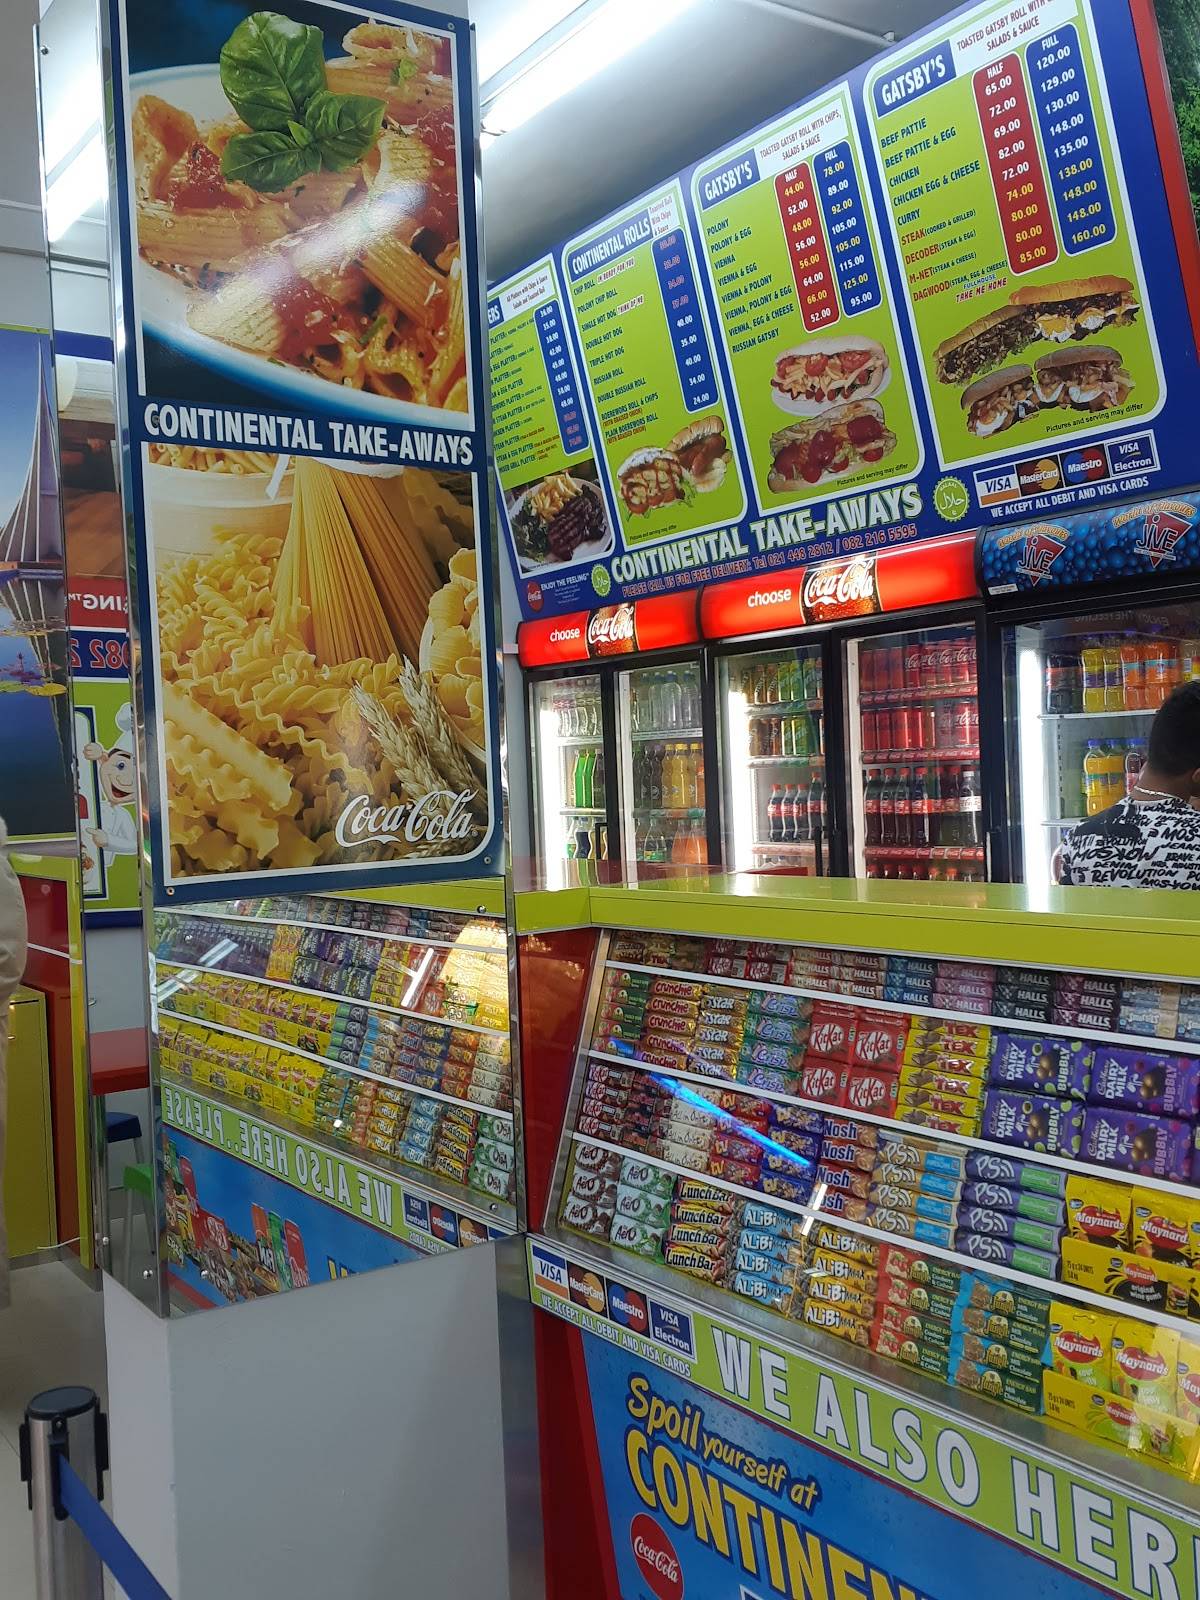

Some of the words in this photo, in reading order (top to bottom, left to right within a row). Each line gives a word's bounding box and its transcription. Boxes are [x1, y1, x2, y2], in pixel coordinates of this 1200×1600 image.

[957, 31, 984, 51] TOASTED
[986, 16, 1009, 36] GATSBY
[1010, 6, 1027, 23] ROLL
[987, 32, 1011, 51] SALADS
[1019, 16, 1039, 34] SAUCE
[1041, 34, 1059, 51] FULL
[1036, 46, 1071, 71] 120.00
[881, 54, 946, 106] GATSBY'S
[986, 63, 1004, 79] HALF
[1041, 68, 1075, 93] 129.00
[985, 75, 1012, 96] 65.00
[989, 97, 1016, 118] 72.00
[1046, 90, 1080, 115] 130.00
[881, 130, 899, 149] BEEF
[901, 118, 927, 139] PATTIE
[994, 118, 1021, 139] 69.00
[1050, 113, 1084, 137] 148.00
[885, 150, 903, 169] BEEF
[906, 139, 932, 159] PATTIE
[933, 134, 939, 146] &
[940, 127, 956, 143] EGG
[998, 140, 1025, 160] 82.00
[1054, 136, 1088, 158] 135.00
[824, 161, 845, 178] 78.00
[889, 166, 920, 188] CHICKEN
[1002, 162, 1030, 181] 72.00
[1058, 158, 1093, 181] 138.00
[704, 161, 752, 201] GATSBY'S
[784, 181, 804, 197] 44.00
[827, 180, 848, 196] 89.00
[893, 186, 924, 207] CHICKEN
[926, 176, 941, 192] EGG
[943, 172, 949, 185] &
[950, 160, 981, 182] CHEESE
[1062, 180, 1098, 202] 148.00
[1006, 183, 1034, 202] 74.00
[788, 200, 808, 216] 52.00
[831, 198, 852, 215] 92.00
[1011, 204, 1038, 222] 80.00
[1067, 202, 1102, 224] 148.00
[706, 218, 729, 236] POLONY
[831, 216, 857, 235] 105.00
[898, 208, 921, 227] CURRY
[710, 236, 733, 254] POLONY
[740, 226, 752, 239] EGG
[796, 236, 816, 251] 56.00
[1016, 225, 1042, 243] 80.00
[1072, 224, 1106, 245] 160.00
[572, 236, 624, 275] CONTINENTAL
[624, 218, 651, 247] ROLLS
[835, 236, 861, 254] 105.00
[1020, 246, 1047, 264] 85.00
[714, 254, 736, 270] VIENNA
[799, 254, 820, 270] 56.00
[839, 254, 864, 272] 115.00
[803, 272, 824, 287] 64.00
[843, 272, 868, 290] 125.00
[807, 290, 828, 305] 66.00
[850, 292, 872, 307] 95.00
[956, 289, 973, 303] TAKE
[976, 284, 988, 298] ME
[810, 308, 832, 323] 52.00
[732, 336, 757, 353] RUSSIAN
[758, 328, 780, 344] GATSBY
[1046, 420, 1072, 433] Pictures
[1072, 418, 1085, 428] and
[1086, 412, 1110, 426] serving
[1110, 408, 1125, 419] may
[1126, 403, 1144, 416] differ
[144, 403, 324, 451] CONTINENTAL
[328, 421, 474, 466] TAKE-AWAYS
[1119, 442, 1139, 454] VISA
[1068, 458, 1102, 474] Maestro
[1114, 458, 1152, 472] Electron
[985, 475, 1012, 494] VISA
[1020, 468, 1058, 485] MasterCard
[991, 506, 1004, 518] WE
[1004, 499, 1033, 516] ACCEPT
[1036, 496, 1050, 510] ALL
[1052, 491, 1076, 506] DEBIT
[1078, 487, 1096, 502] AND
[1098, 482, 1118, 498] VISA
[1121, 476, 1149, 493] CARDS
[611, 526, 749, 584] CONTINENTAL
[750, 483, 924, 552] TAKE-AWAYS
[666, 578, 674, 591] US
[675, 574, 691, 588] FOR
[692, 570, 711, 584] FREE
[752, 556, 766, 569] Tel
[768, 553, 786, 566] 021
[788, 548, 806, 561] 448
[808, 542, 834, 558] 2812
[842, 536, 864, 550] 082
[866, 531, 886, 545] 216
[889, 524, 918, 541] 5595
[748, 588, 792, 608] choose
[804, 559, 875, 608] Coca-Cola
[550, 628, 580, 642] choose
[588, 606, 635, 644] Coca-Cola
[335, 789, 480, 848] Coca-Cola
[904, 992, 929, 1003] HALLS
[1078, 1013, 1111, 1028] HALLS
[811, 1025, 843, 1052] KitKat
[858, 1033, 892, 1060] KitKat
[1006, 1043, 1022, 1081] DAIRY
[1014, 1048, 1026, 1079] MILK
[1057, 1047, 1072, 1092] BUBBLY
[824, 1121, 857, 1138] Nosh
[821, 1142, 854, 1160] Nosh
[1075, 1212, 1126, 1230] Maynards
[540, 1261, 562, 1284] VISA
[569, 1276, 604, 1301] MasterCard
[612, 1296, 644, 1320] Maestro
[660, 1308, 679, 1326] VISA
[540, 1292, 553, 1308] WE
[554, 1300, 580, 1322] ACCEPT
[582, 1315, 596, 1332] ALL
[598, 1322, 620, 1343] DEBIT
[622, 1333, 639, 1351] AND
[640, 1342, 660, 1362] VISA
[662, 1352, 691, 1378] CARDS
[654, 1326, 690, 1352] Electron
[1054, 1336, 1104, 1358] Maynards
[627, 1377, 701, 1451] Spoil
[702, 1431, 788, 1493] yourself
[790, 1478, 818, 1510] at
[711, 1325, 791, 1422] WE
[814, 1372, 981, 1508] ALSO
[1010, 1455, 1200, 1600] HER
[634, 1536, 679, 1584] Coca-Cola
